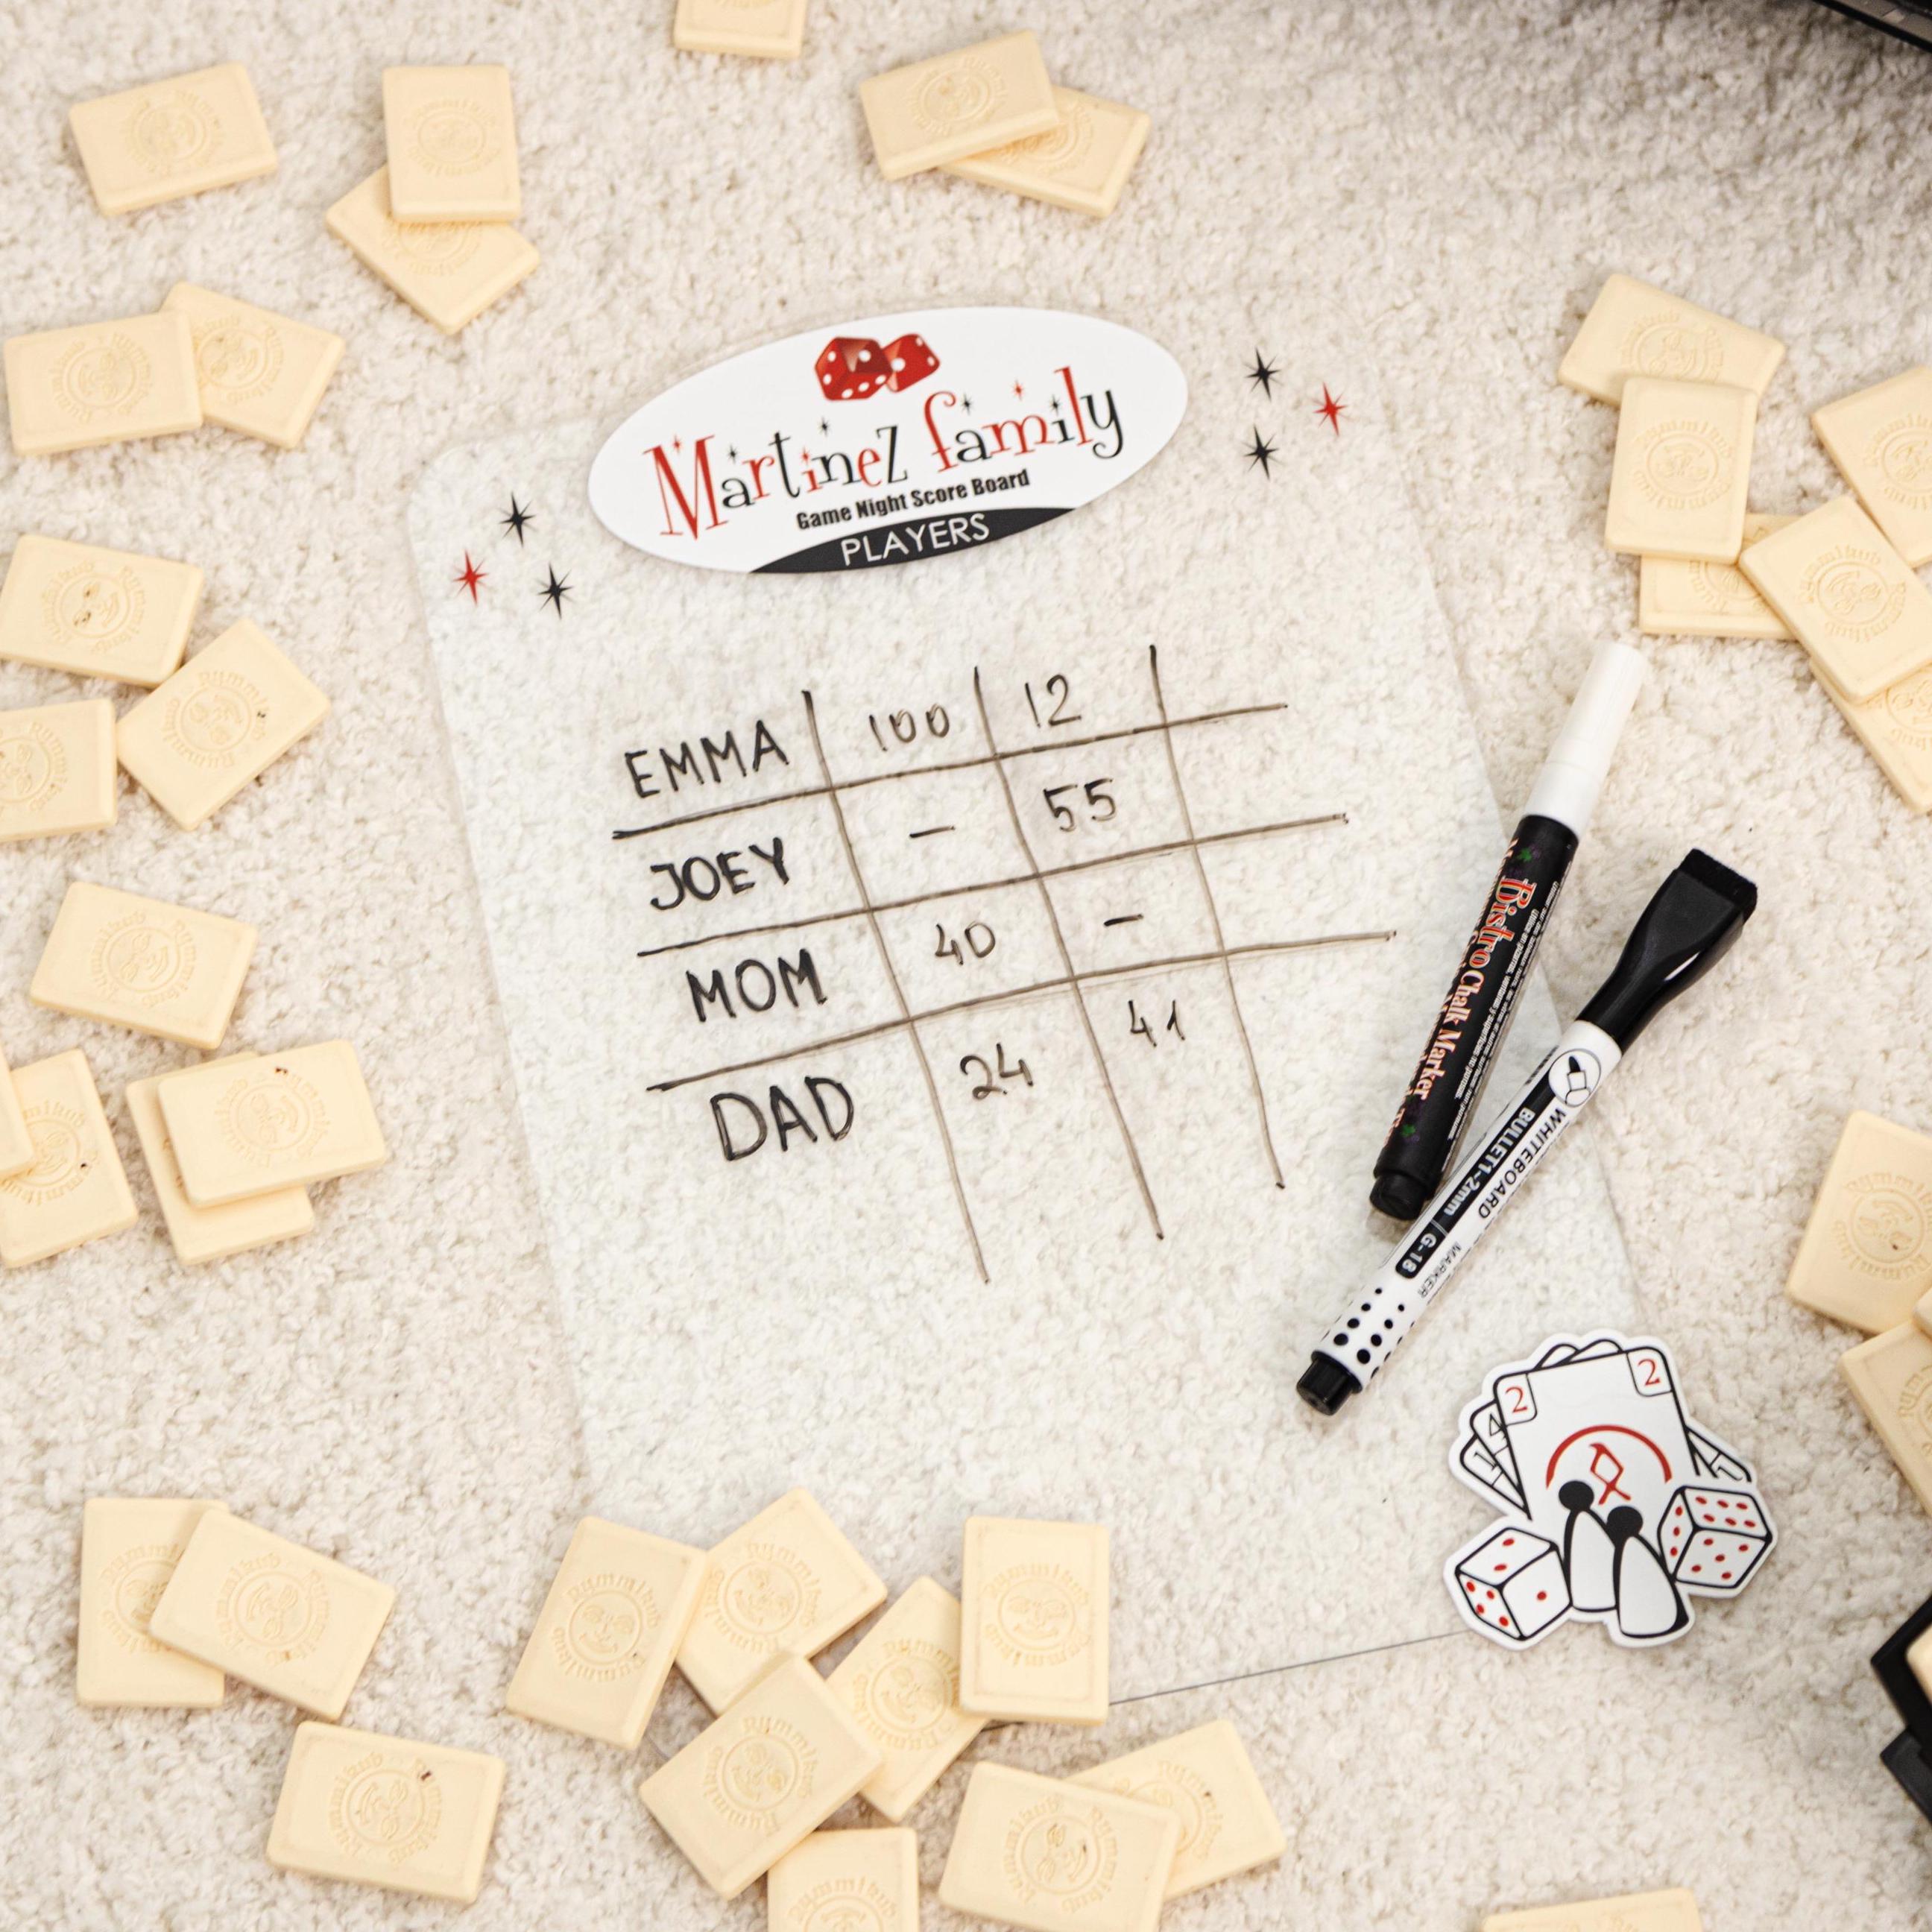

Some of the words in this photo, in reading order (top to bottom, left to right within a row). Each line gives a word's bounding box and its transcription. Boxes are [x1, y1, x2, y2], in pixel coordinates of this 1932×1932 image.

[922, 365, 1124, 474] family
[796, 505, 851, 531] Game
[856, 493, 908, 522] Night
[910, 482, 968, 510] Score
[972, 468, 1030, 496] Board
[841, 512, 990, 566] PLAYERS
[624, 720, 789, 798] EMMA
[869, 704, 950, 751] 100
[1025, 673, 1081, 727] 12
[651, 837, 789, 910] JOEY
[1044, 779, 1116, 831] 55
[1470, 876, 1536, 968] Bistro
[685, 947, 827, 1022] MOM
[934, 921, 997, 965] 40
[1443, 970, 1484, 1024] Chalk
[710, 1076, 855, 1161] DAD
[960, 1043, 1033, 1099] 24
[1128, 999, 1185, 1046] 41
[1415, 1021, 1460, 1100] Marker
[1477, 1106, 1567, 1220] WHITEBOARD
[1401, 1230, 1439, 1273] G-18
[1417, 1241, 1462, 1300] MARKER
[1504, 1386, 1528, 1413] 2
[1637, 1358, 1661, 1386] 2
